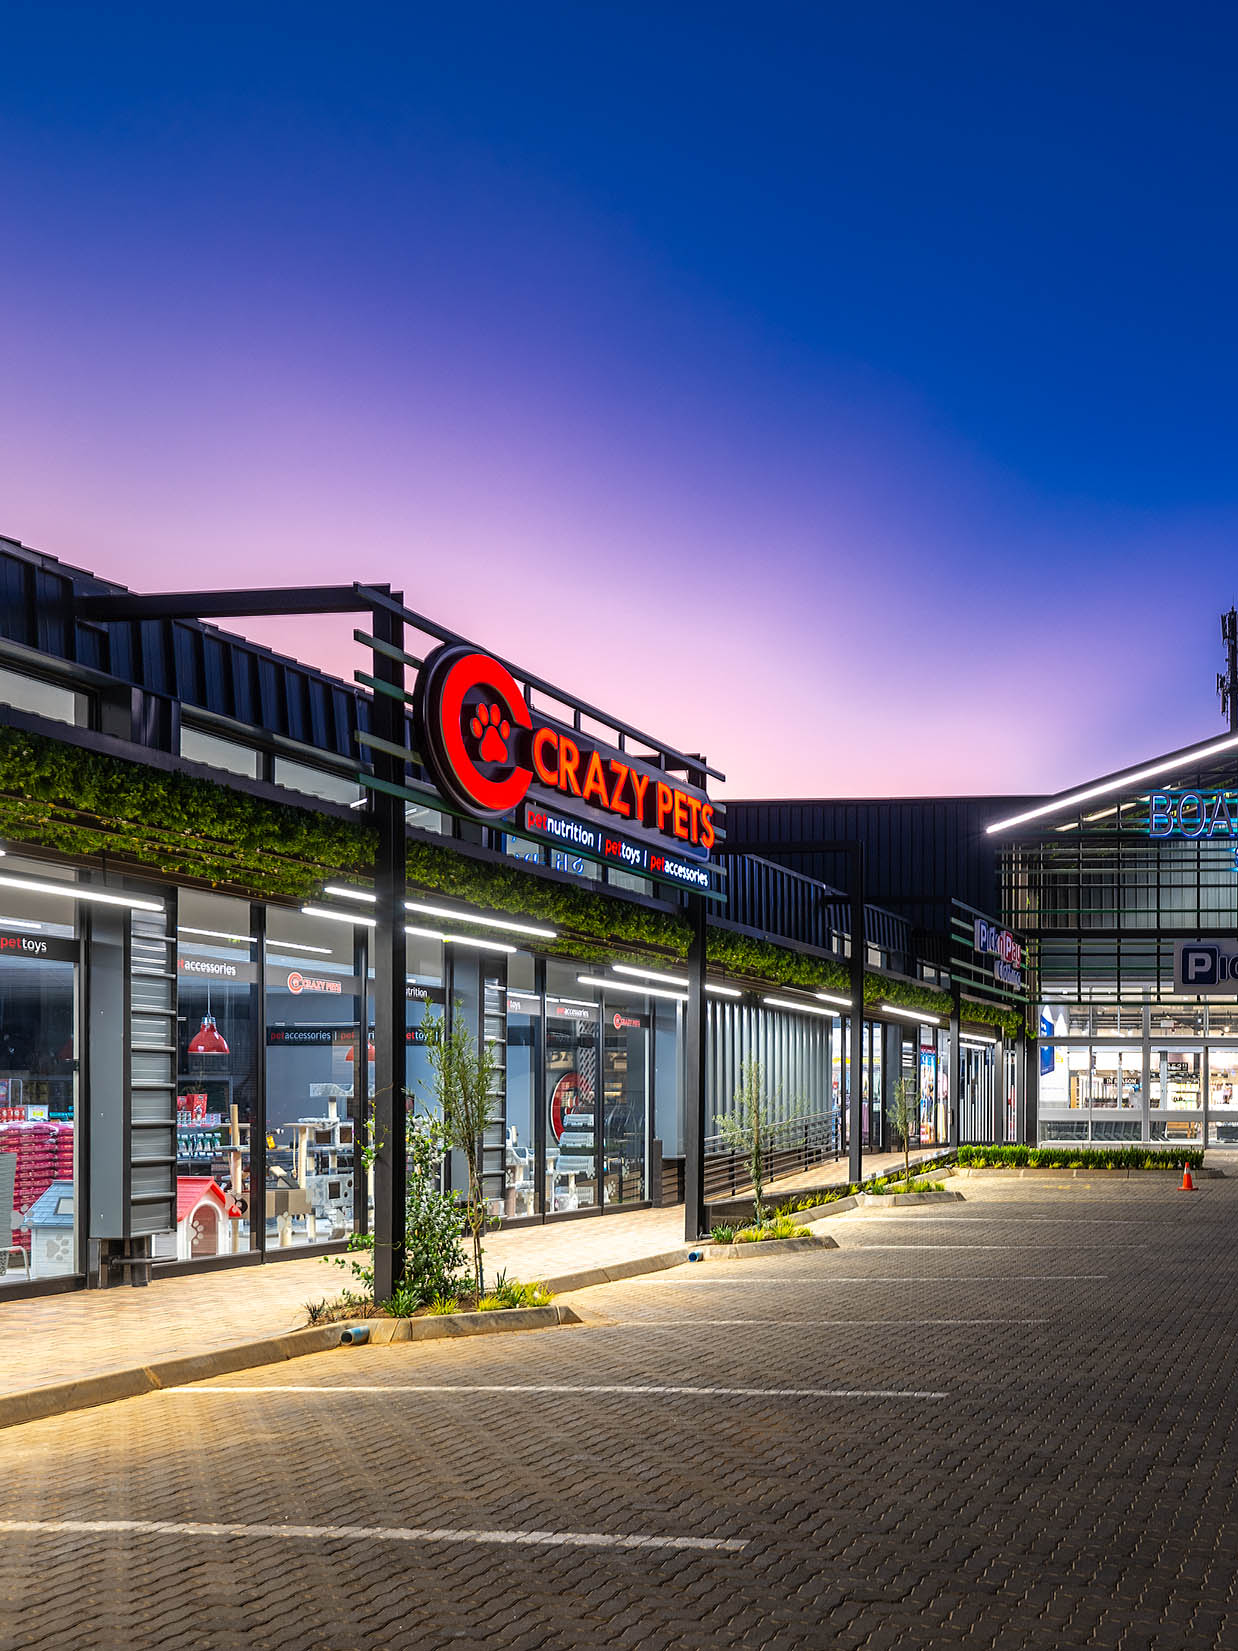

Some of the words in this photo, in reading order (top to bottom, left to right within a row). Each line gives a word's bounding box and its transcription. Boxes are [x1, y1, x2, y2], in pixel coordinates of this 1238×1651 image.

[532, 727, 650, 822] CRAZY
[656, 780, 716, 849] PETS
[527, 810, 594, 848] petnutrition
[604, 837, 641, 865] pettoys
[649, 854, 709, 887] petaccessories
[0, 937, 47, 954] pettoys
